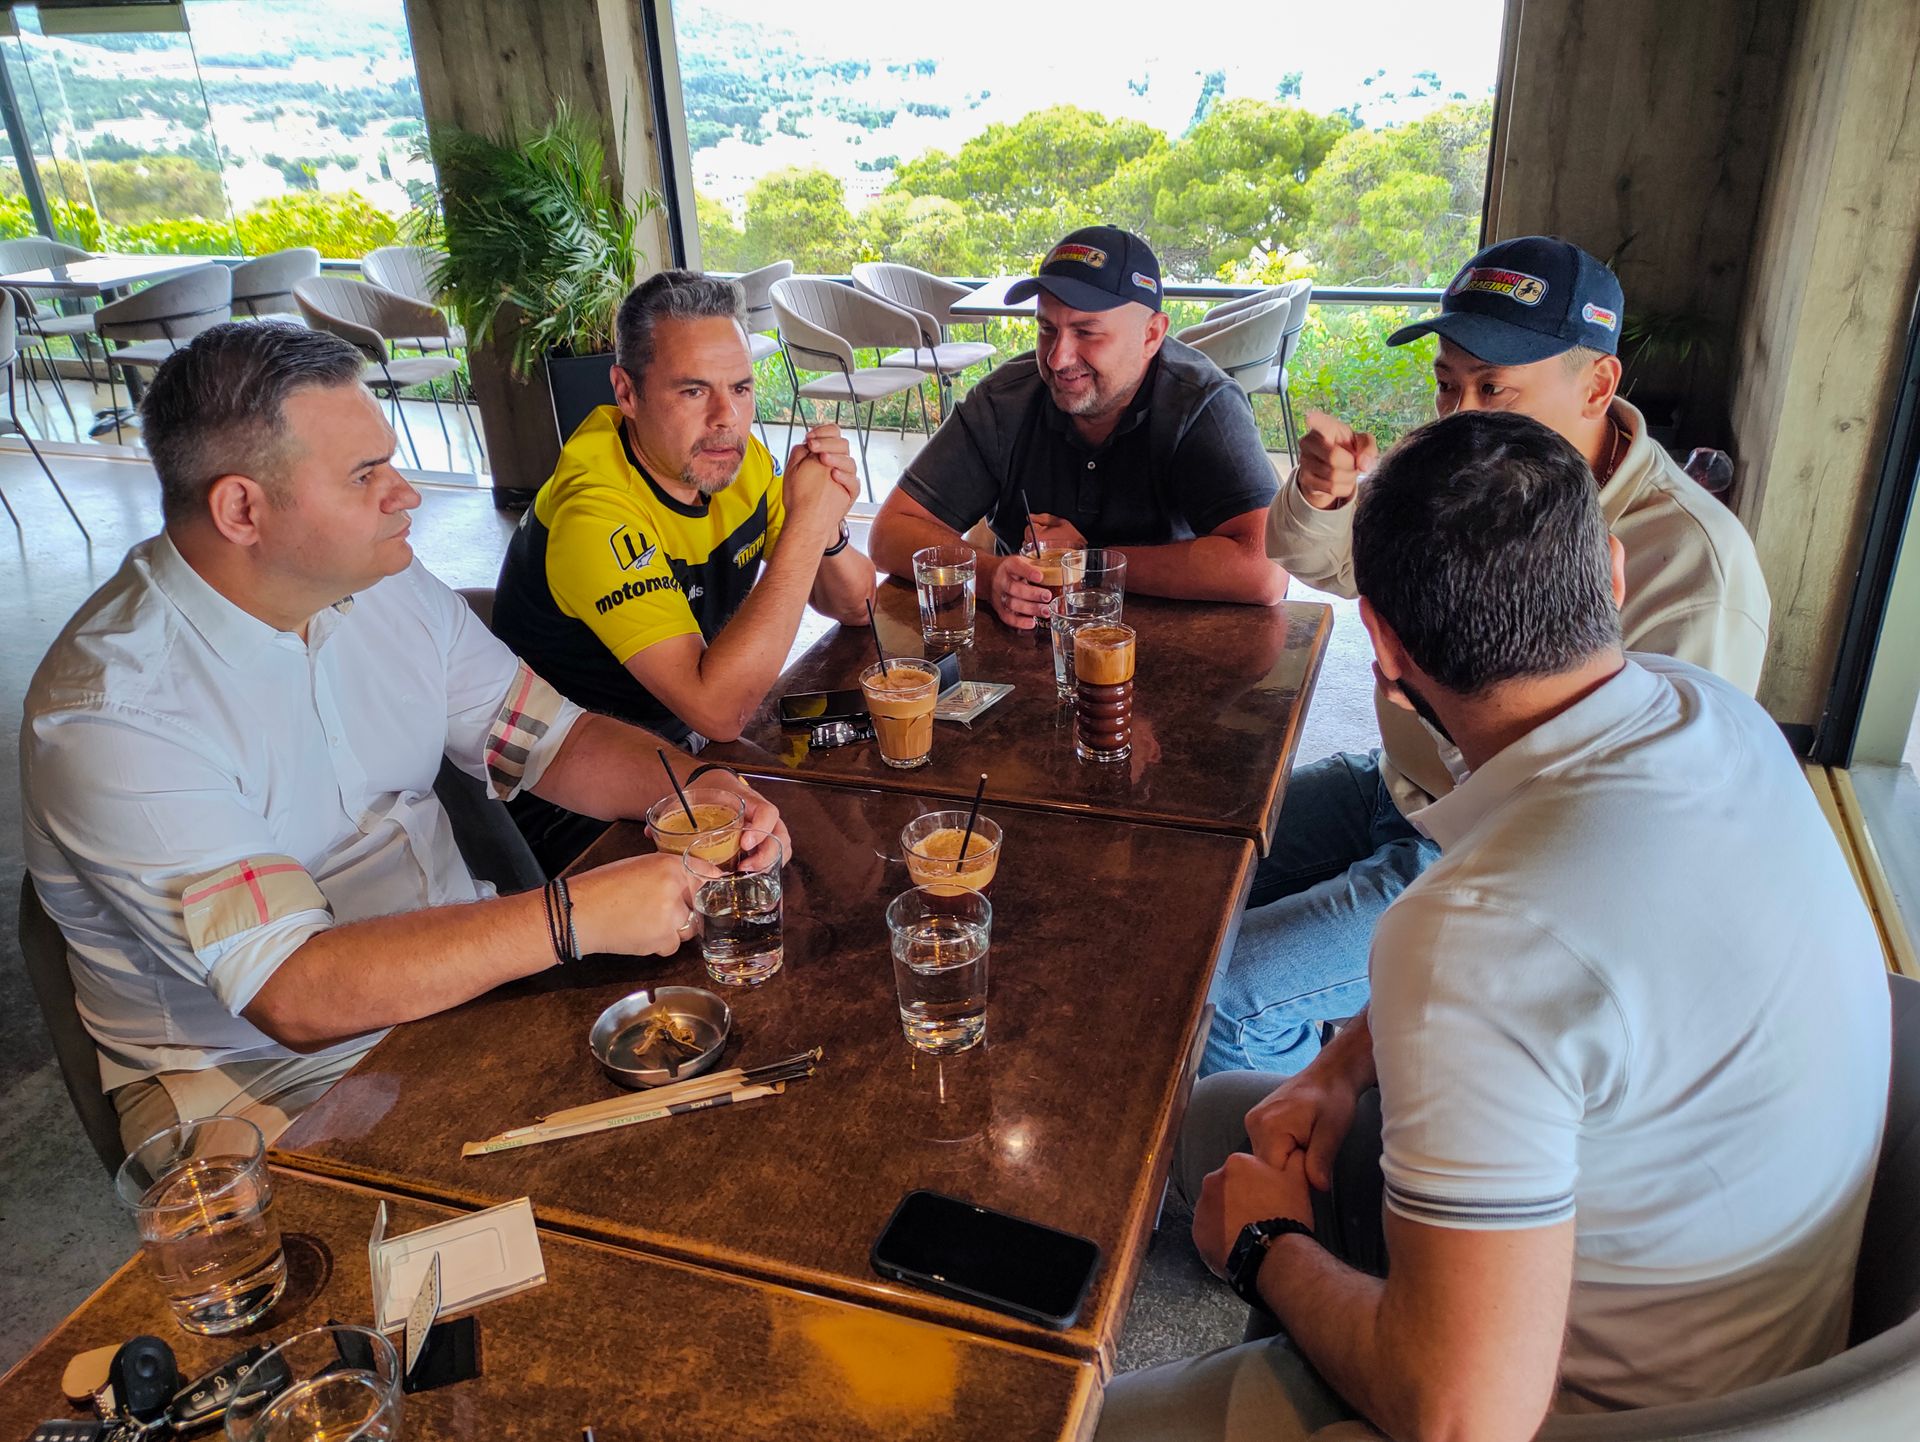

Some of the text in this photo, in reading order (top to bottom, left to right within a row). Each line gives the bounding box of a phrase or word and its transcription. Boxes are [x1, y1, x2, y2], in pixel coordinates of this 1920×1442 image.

[1469, 280, 1514, 294] RACING
[690, 1099, 713, 1109] BLACK
[607, 1116, 632, 1126] PLASTIC
[633, 1112, 650, 1121] MORE
